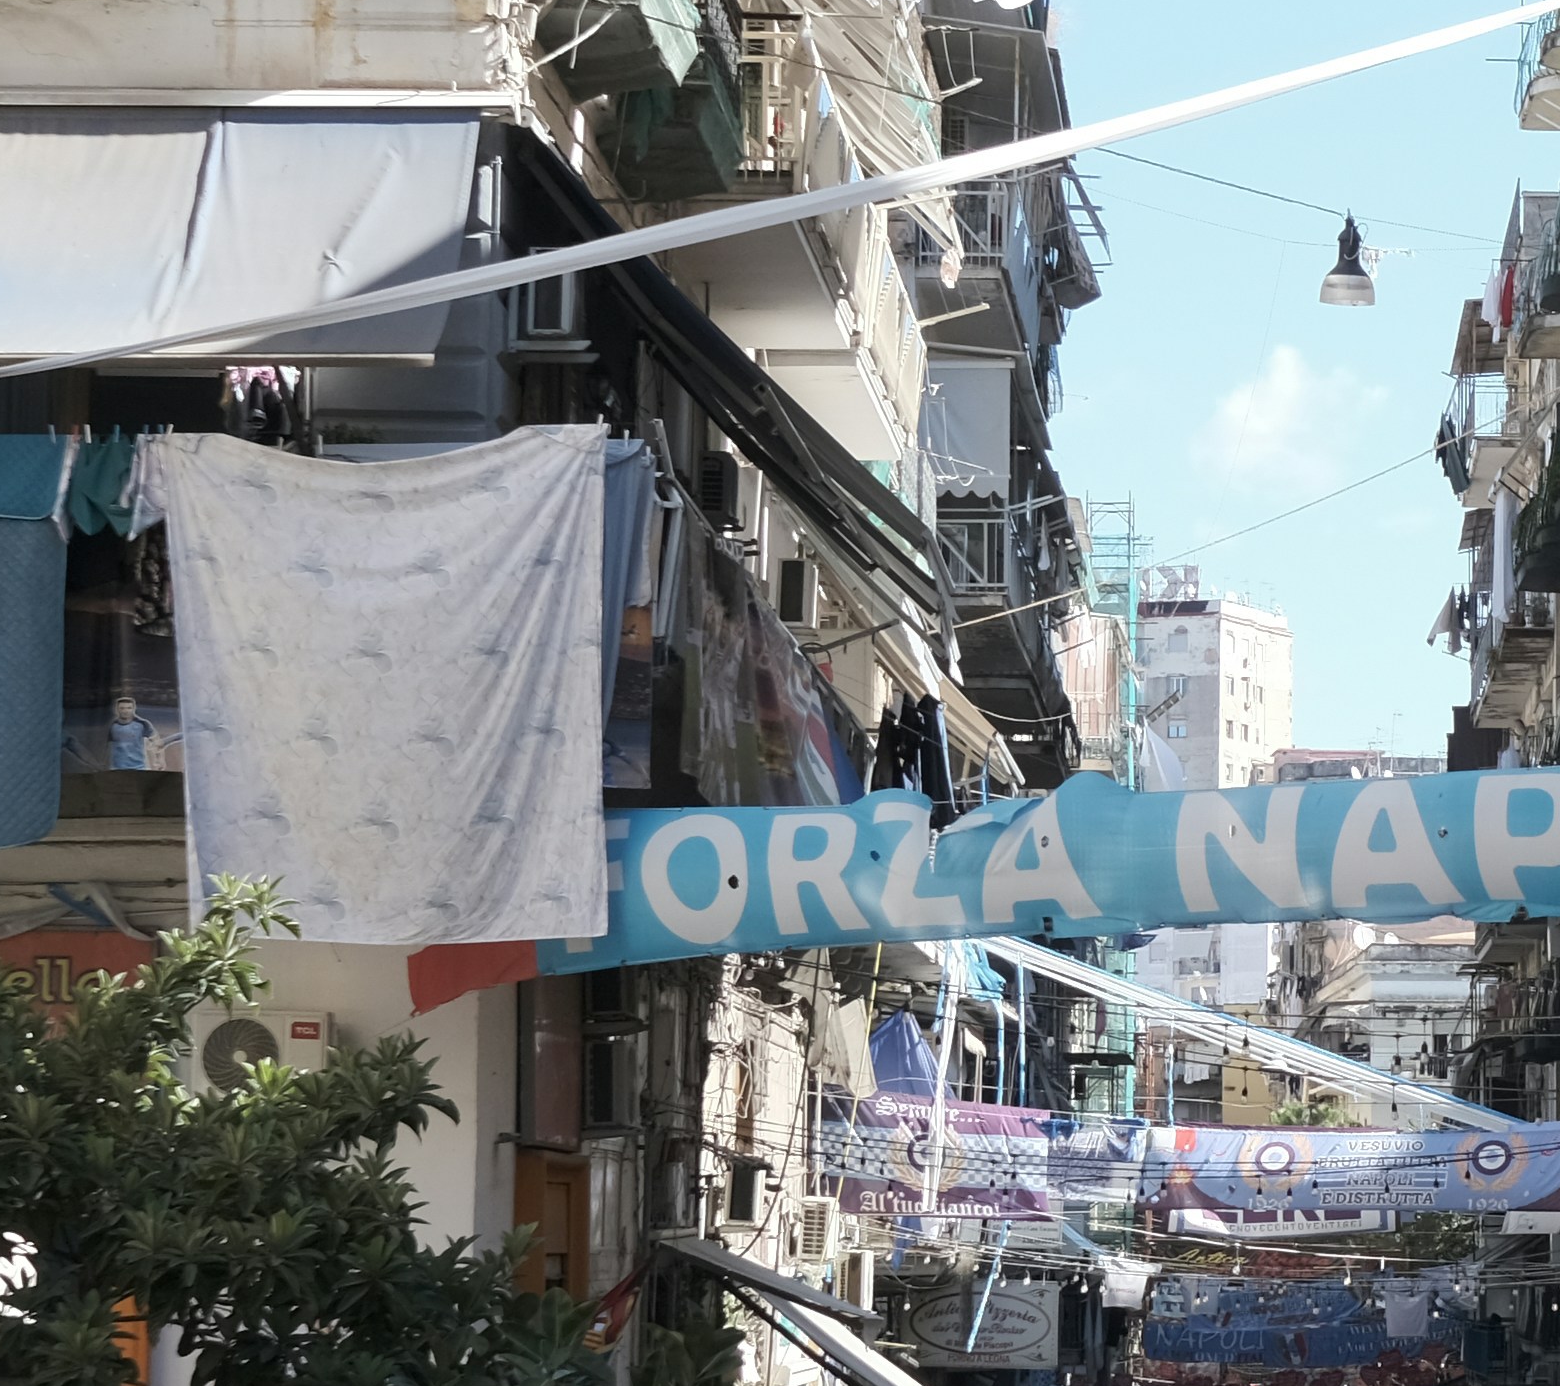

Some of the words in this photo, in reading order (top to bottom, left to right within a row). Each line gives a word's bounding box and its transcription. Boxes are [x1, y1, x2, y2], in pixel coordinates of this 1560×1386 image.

[567, 797, 1102, 953] ORZA
[1348, 1140, 1424, 1152] VESUVIO
[1347, 1173, 1414, 1186] NAPOLI
[1336, 1192, 1434, 1205] DISTRUTTA
[1467, 1198, 1509, 1211] 1926
